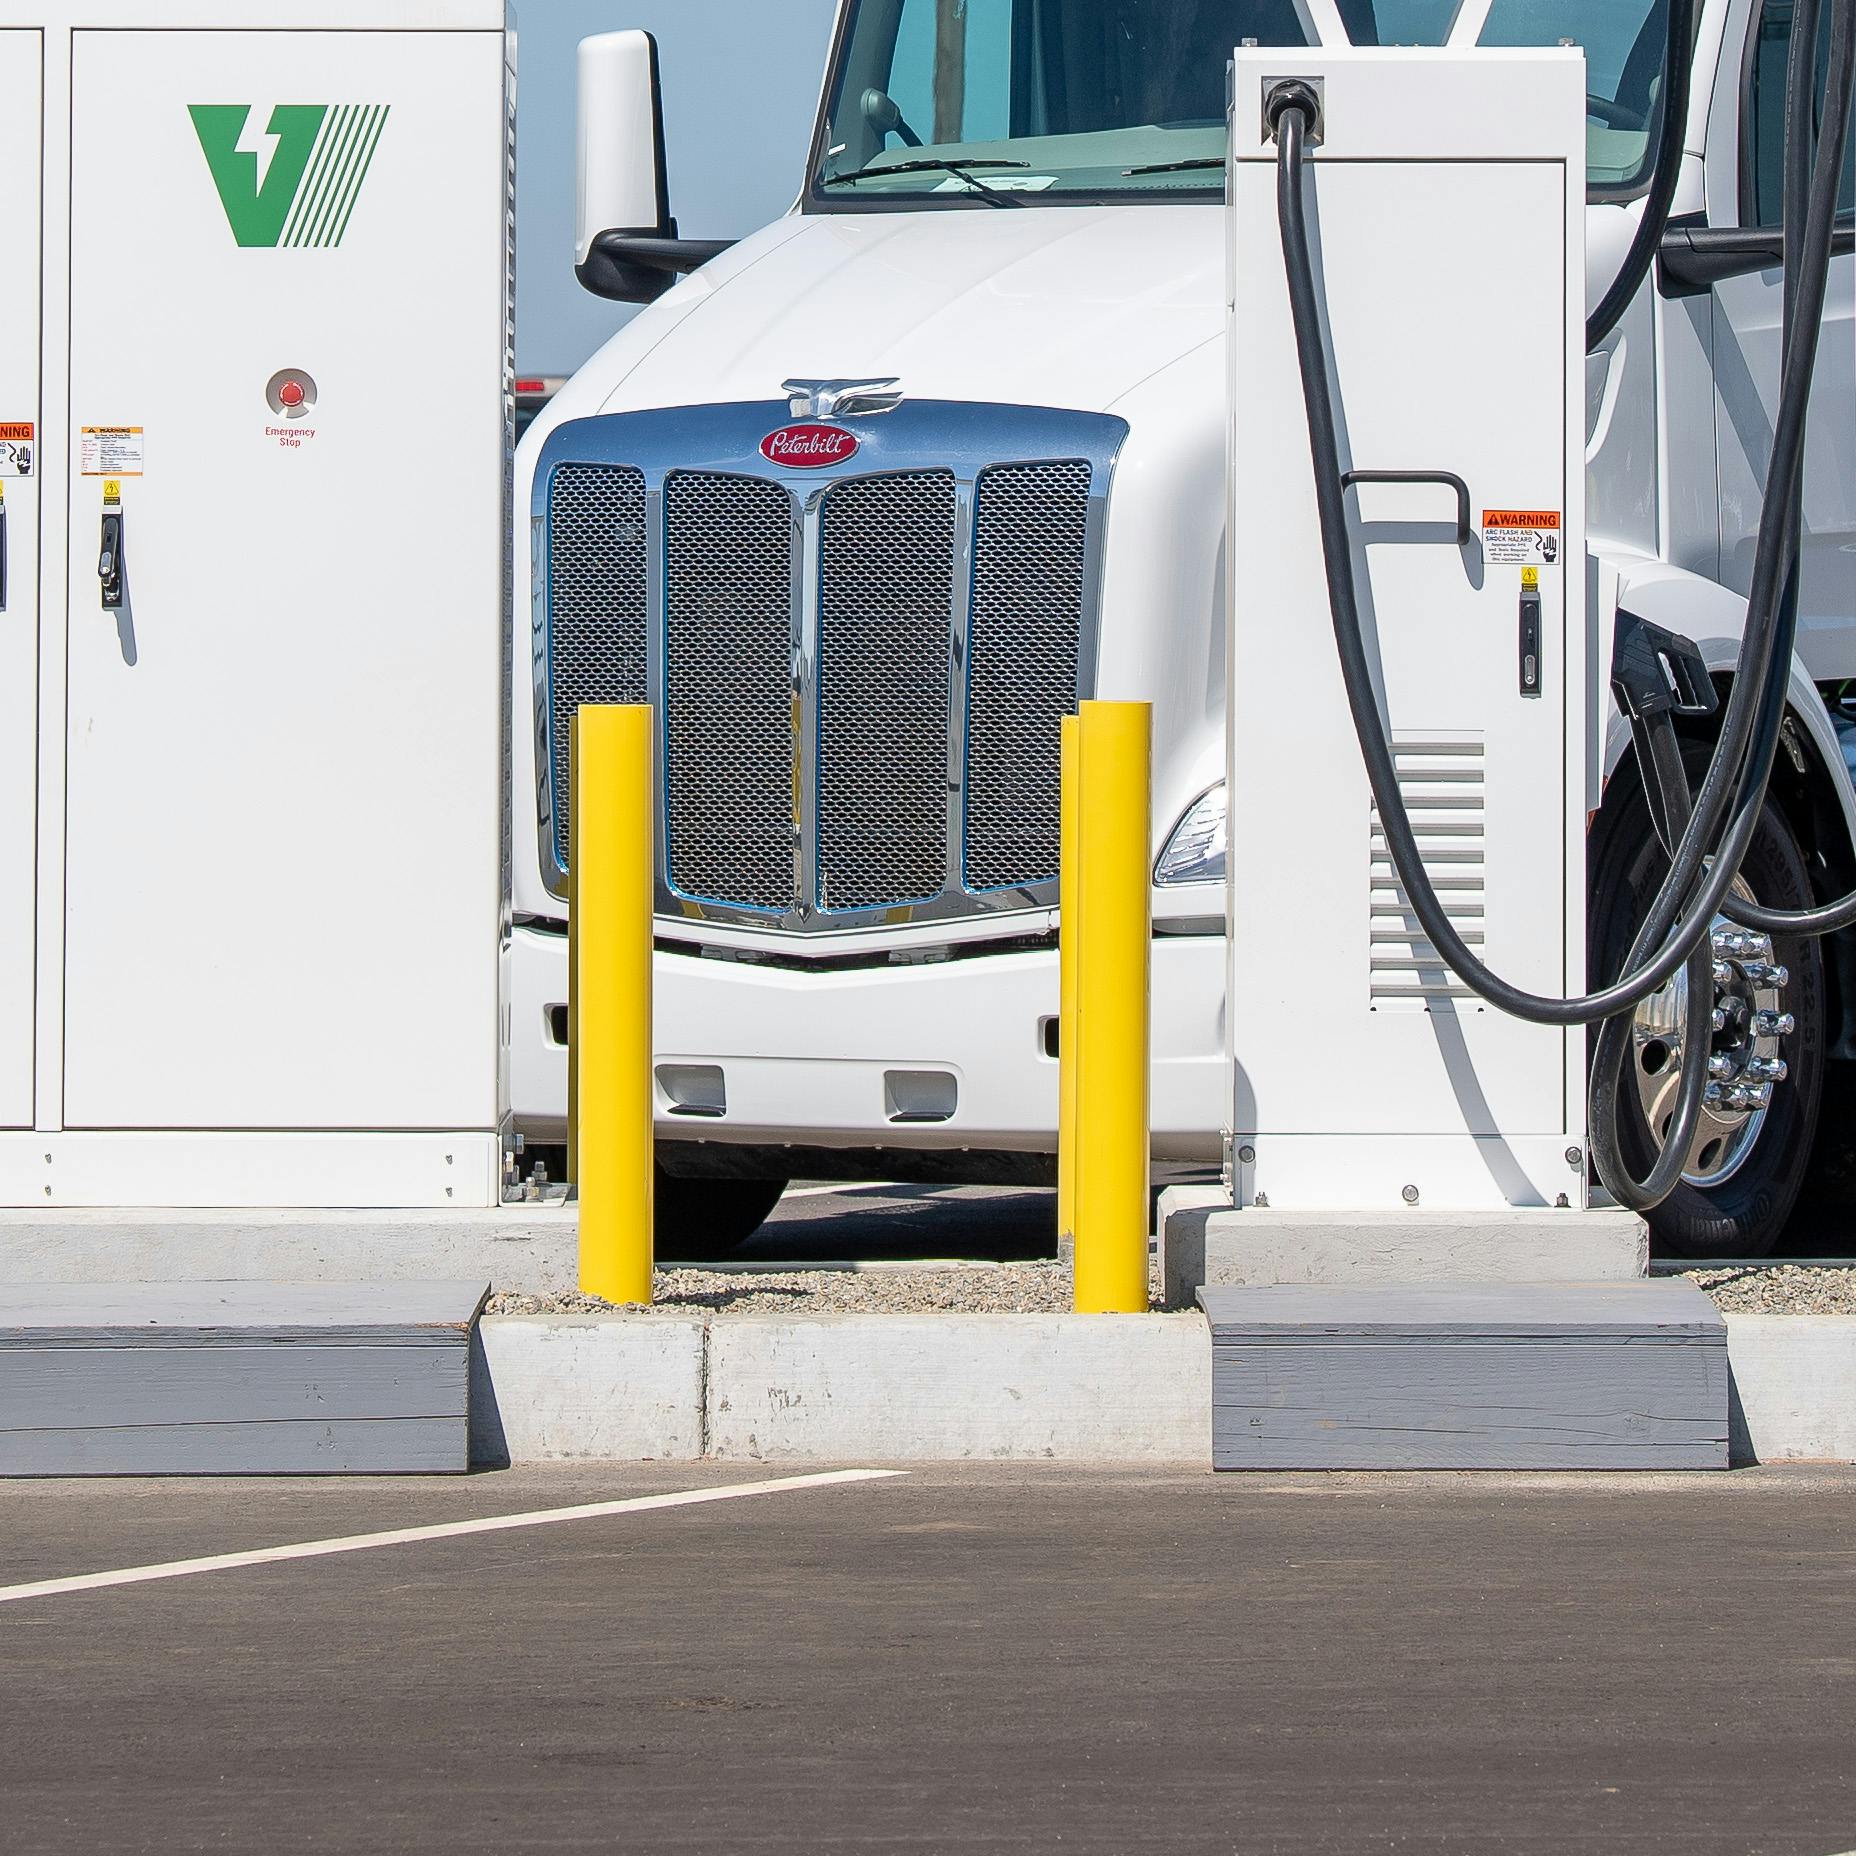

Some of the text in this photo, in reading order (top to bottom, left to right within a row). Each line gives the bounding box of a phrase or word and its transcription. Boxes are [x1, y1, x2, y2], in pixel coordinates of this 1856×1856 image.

[265, 426, 316, 438] Emergency
[279, 437, 301, 448] Stop
[769, 431, 852, 457] Peterbilt
[1500, 514, 1556, 526] WARNING
